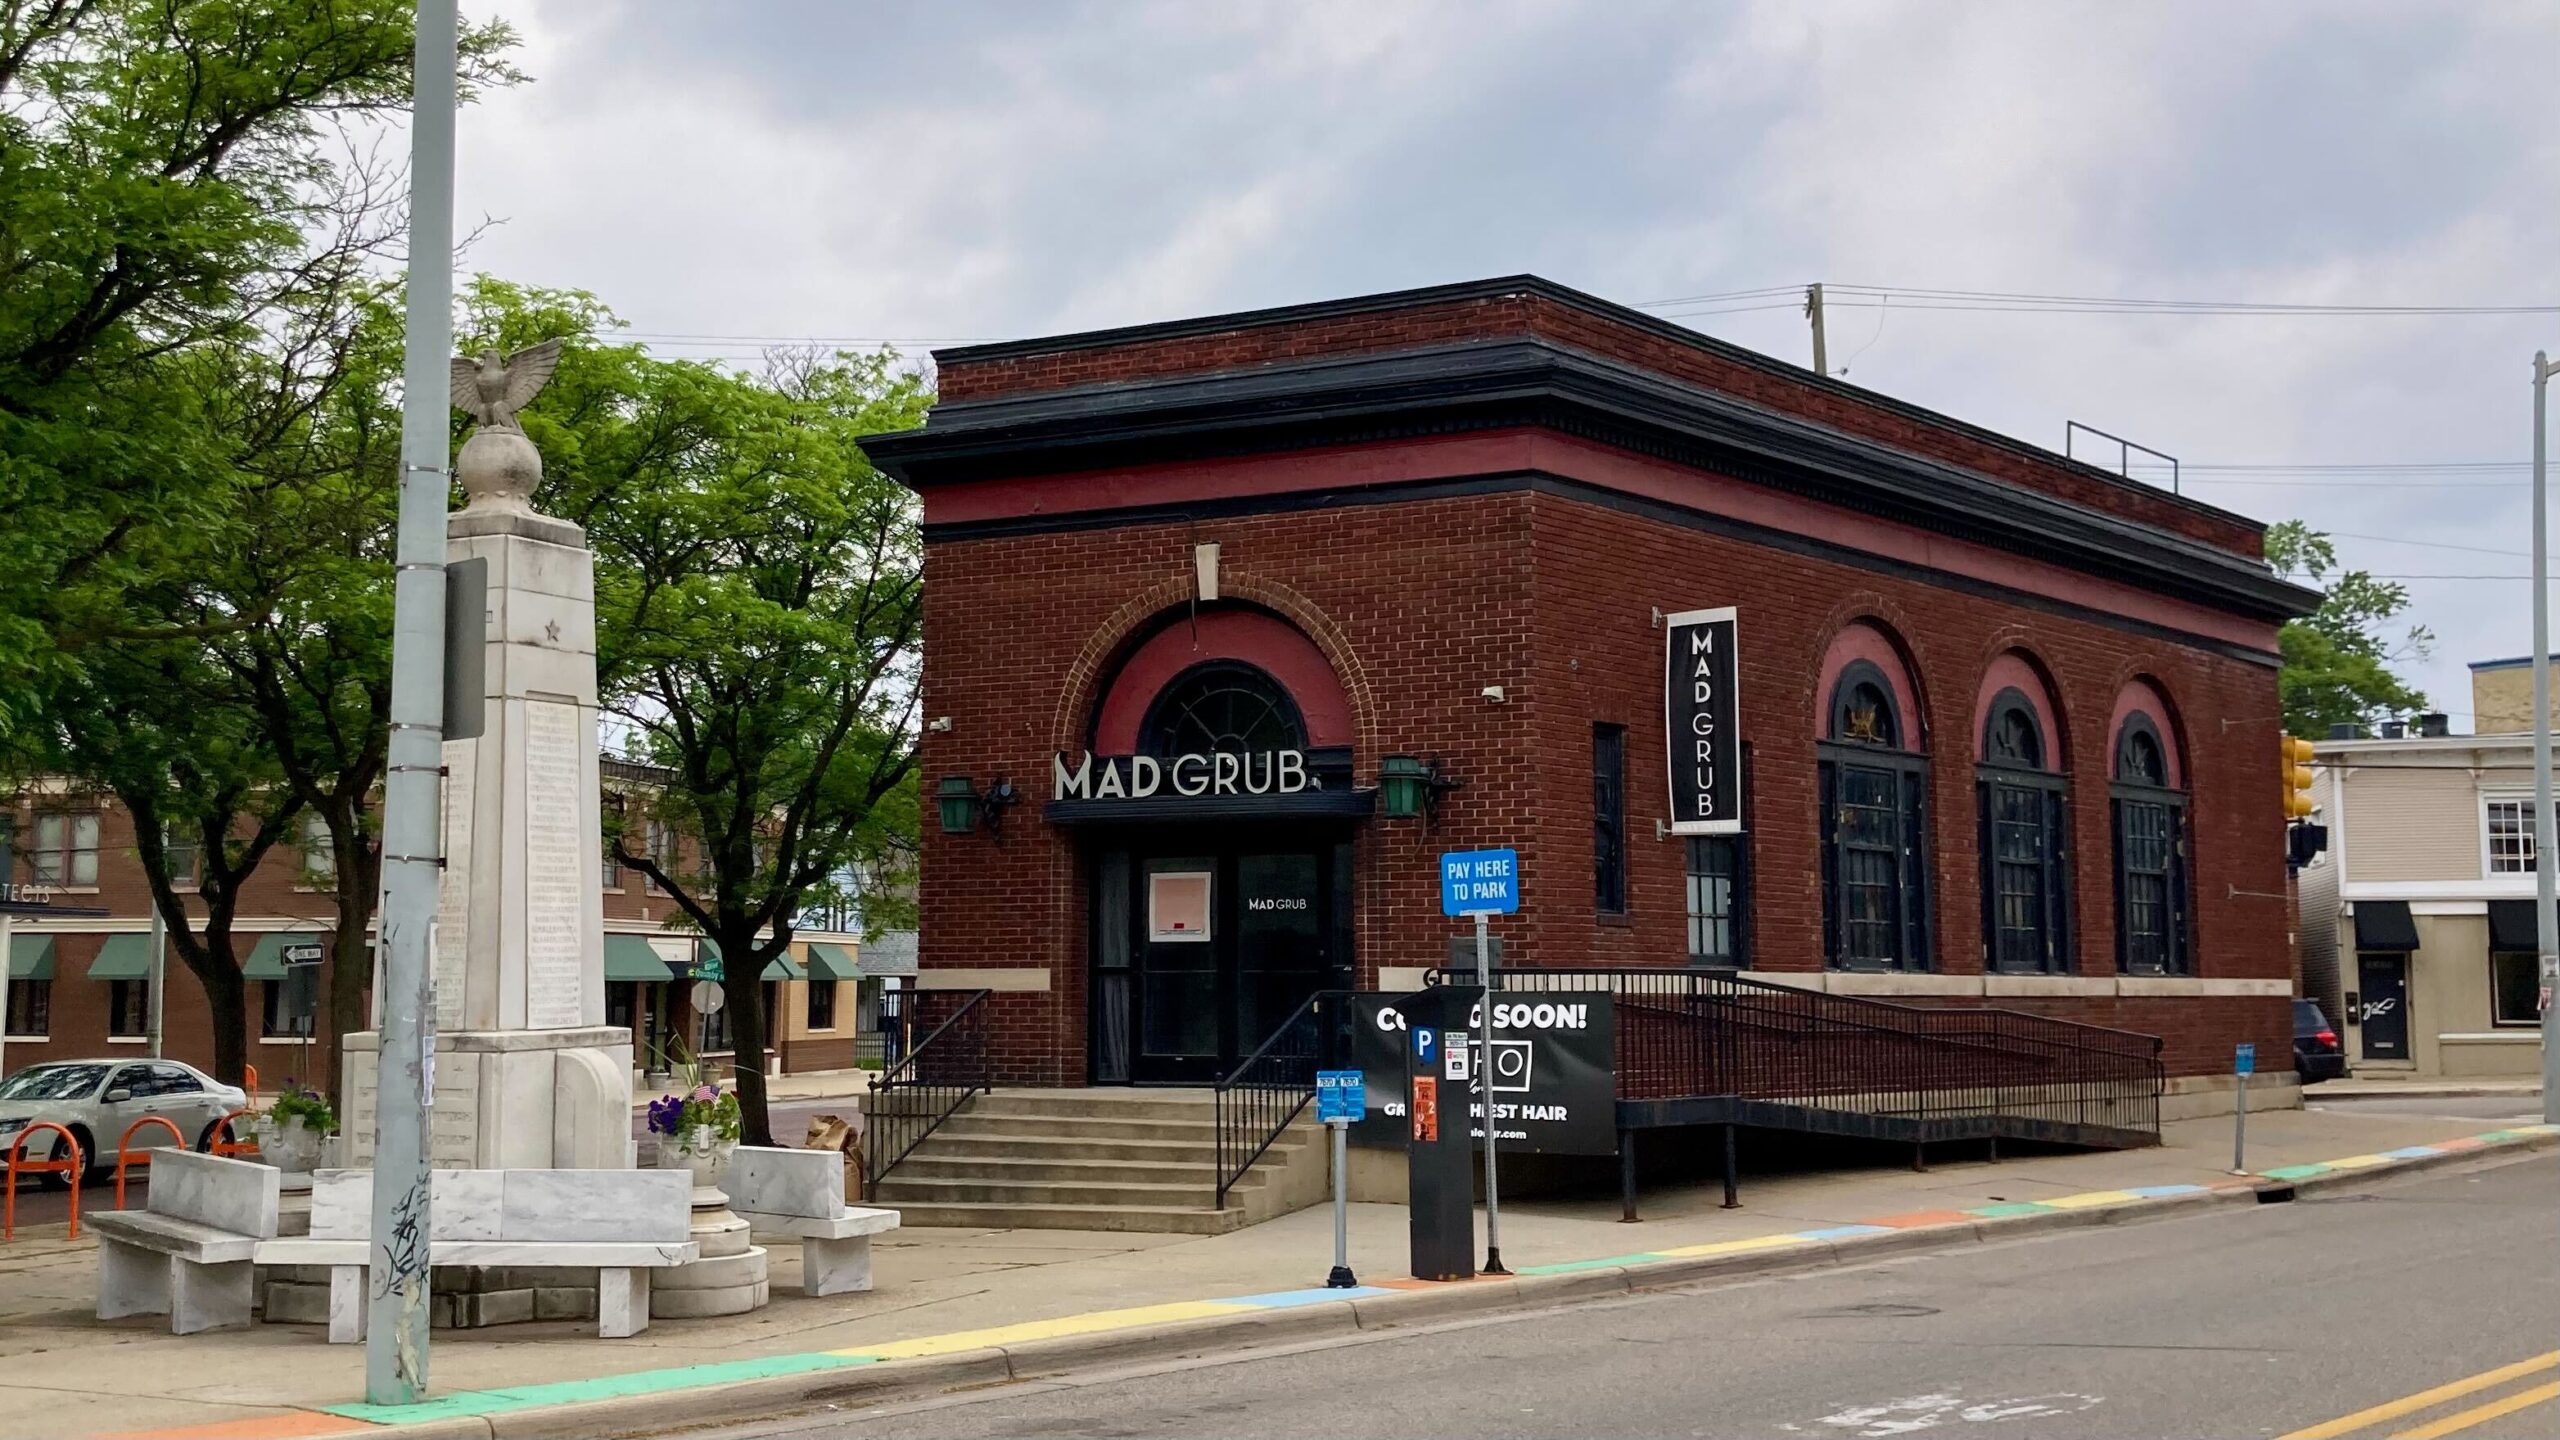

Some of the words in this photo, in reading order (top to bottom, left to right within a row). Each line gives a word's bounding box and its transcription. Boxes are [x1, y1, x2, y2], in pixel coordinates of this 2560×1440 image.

[1691, 628, 1713, 703] MAD
[1054, 749, 1161, 800] MAD
[1172, 749, 1307, 796] GRUB
[1692, 712, 1714, 817] GRUB
[1447, 862, 1470, 879] PAY
[1475, 859, 1510, 878] HERE
[1452, 883, 1469, 900] TO
[1473, 881, 1507, 899] PARK
[1249, 897, 1275, 910] MAD
[1276, 898, 1307, 910] GRUB
[1492, 1003, 1588, 1029] SOON!
[1418, 1030, 1432, 1056] P
[1428, 1101, 1435, 1114] 2
[1521, 1104, 1568, 1122] HAIR
